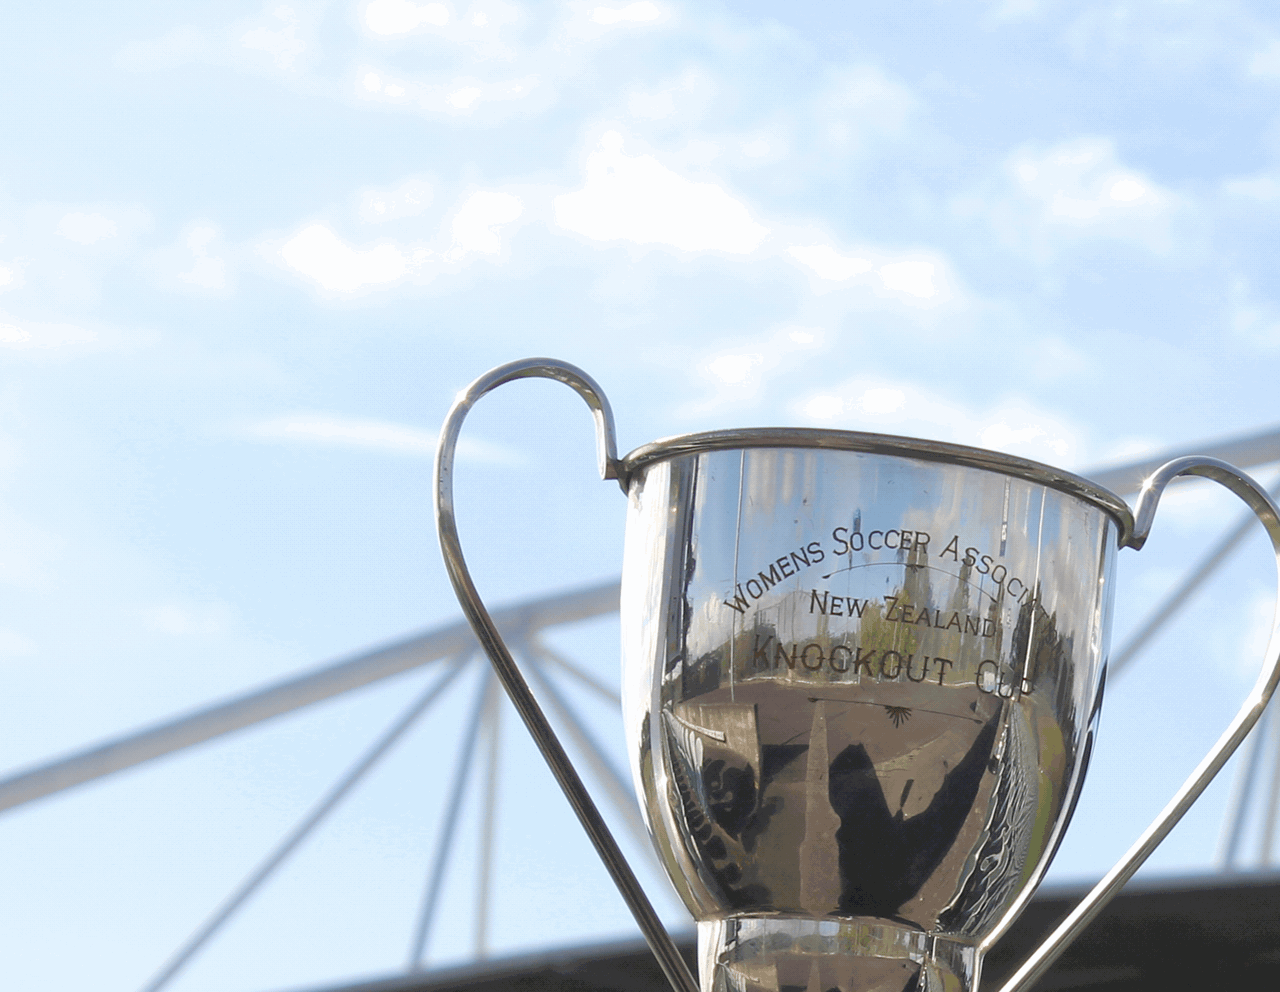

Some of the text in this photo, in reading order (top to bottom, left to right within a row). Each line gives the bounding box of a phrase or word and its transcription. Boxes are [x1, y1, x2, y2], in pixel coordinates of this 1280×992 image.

[723, 541, 825, 615] WOMENS
[832, 527, 931, 556] SOCCER
[809, 589, 997, 638] NEW ZEALAND
[753, 634, 1035, 702] KNOCKOUT CUP
